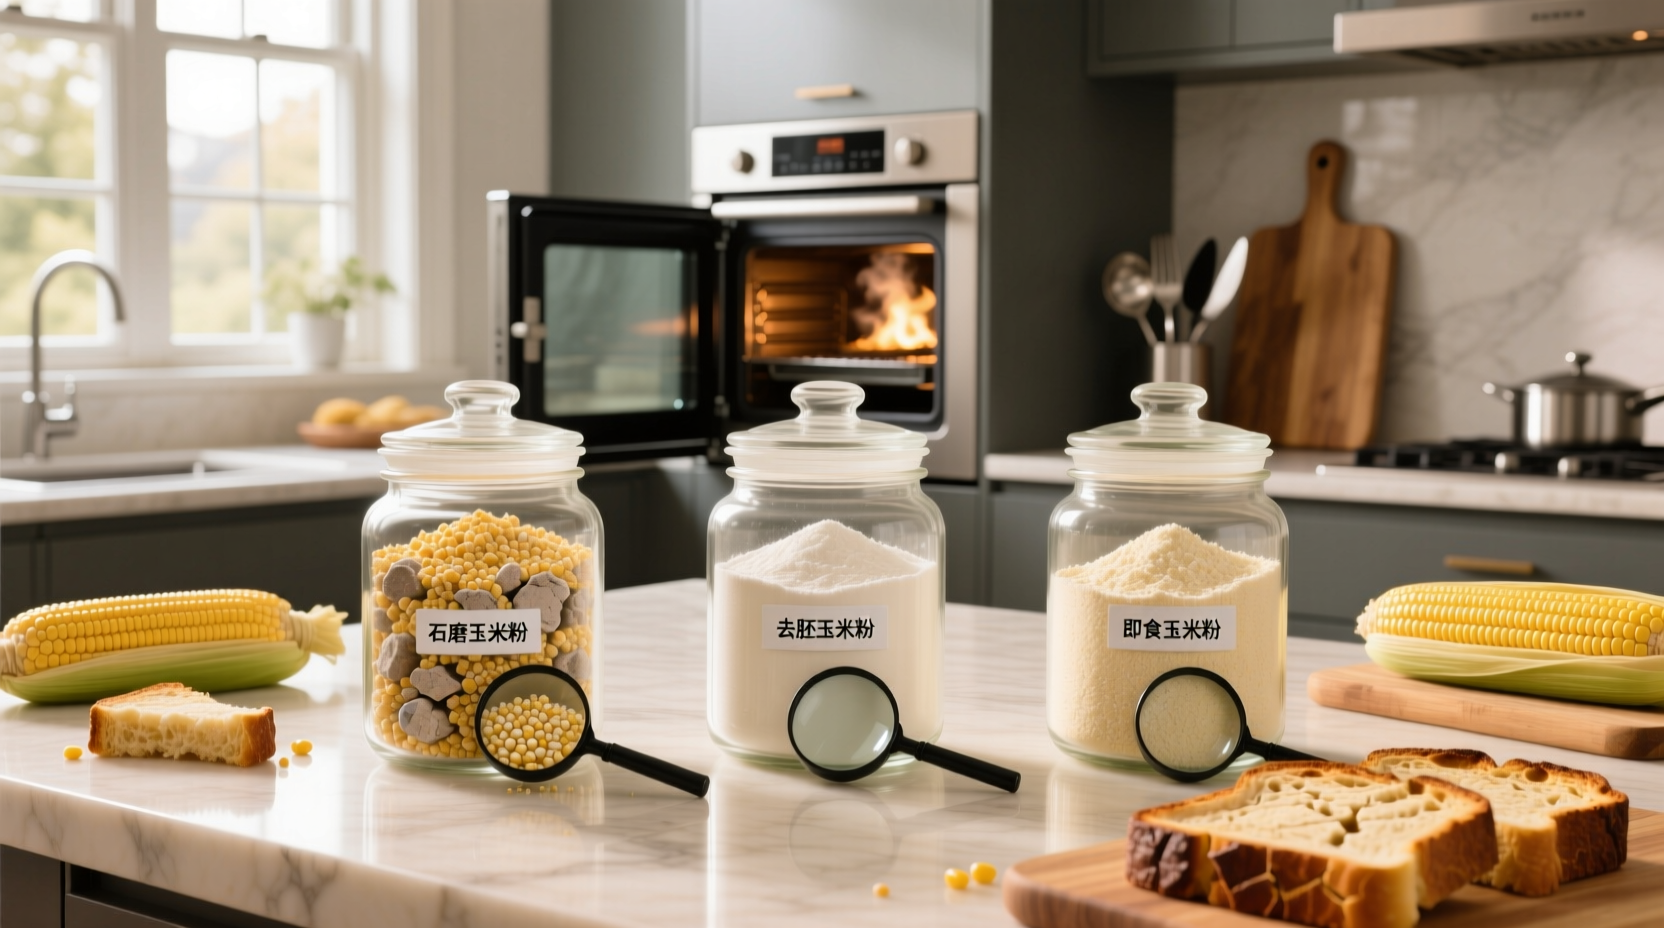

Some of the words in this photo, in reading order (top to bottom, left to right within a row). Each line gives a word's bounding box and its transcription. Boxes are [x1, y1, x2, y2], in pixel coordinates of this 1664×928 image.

[428, 621, 528, 643] 石磨玉米粉
[776, 617, 875, 640] 去胚玉米粉
[1123, 618, 1221, 640] 即食玉米粉
